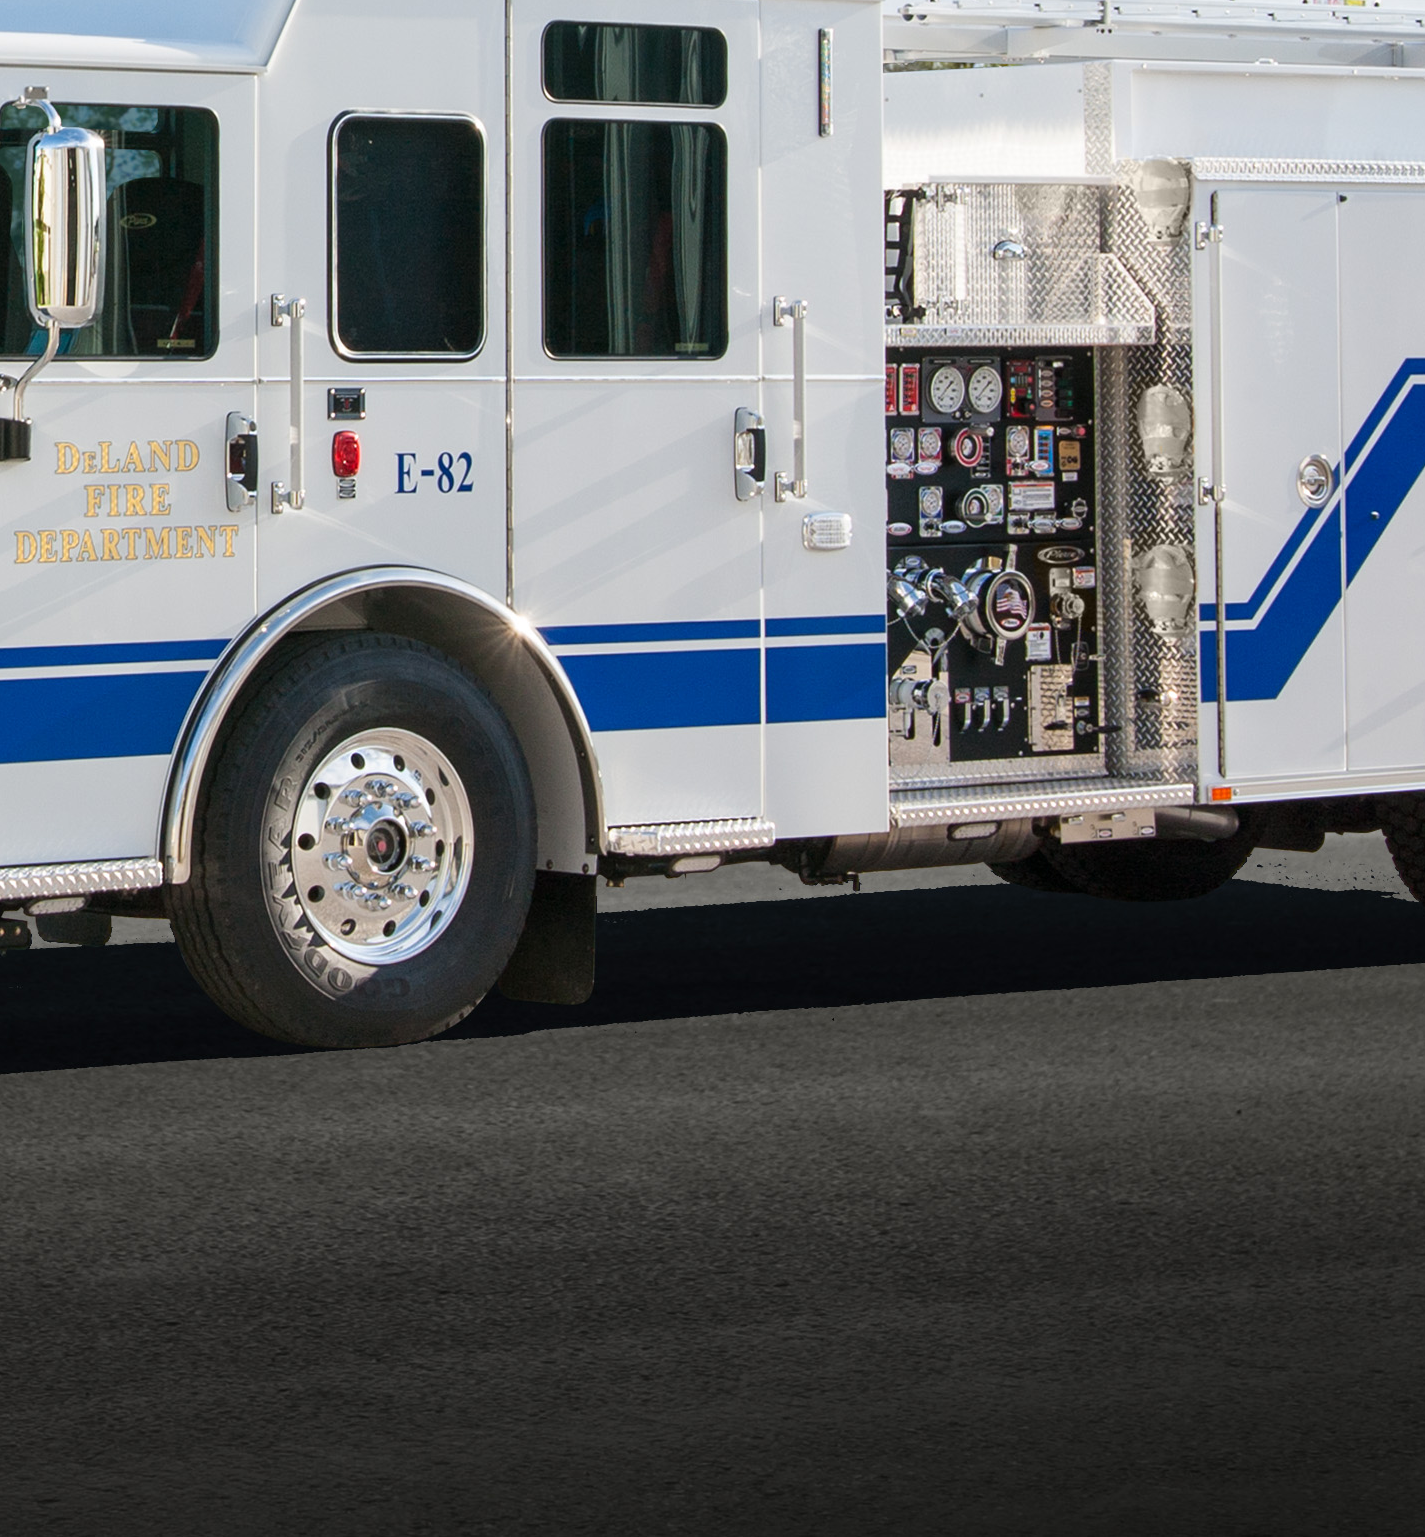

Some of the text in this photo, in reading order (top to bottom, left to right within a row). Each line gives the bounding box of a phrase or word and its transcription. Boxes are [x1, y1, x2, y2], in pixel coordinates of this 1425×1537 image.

[395, 451, 474, 494] E-82
[84, 483, 171, 517] FIRE
[14, 524, 239, 564] DEPARTMENT
